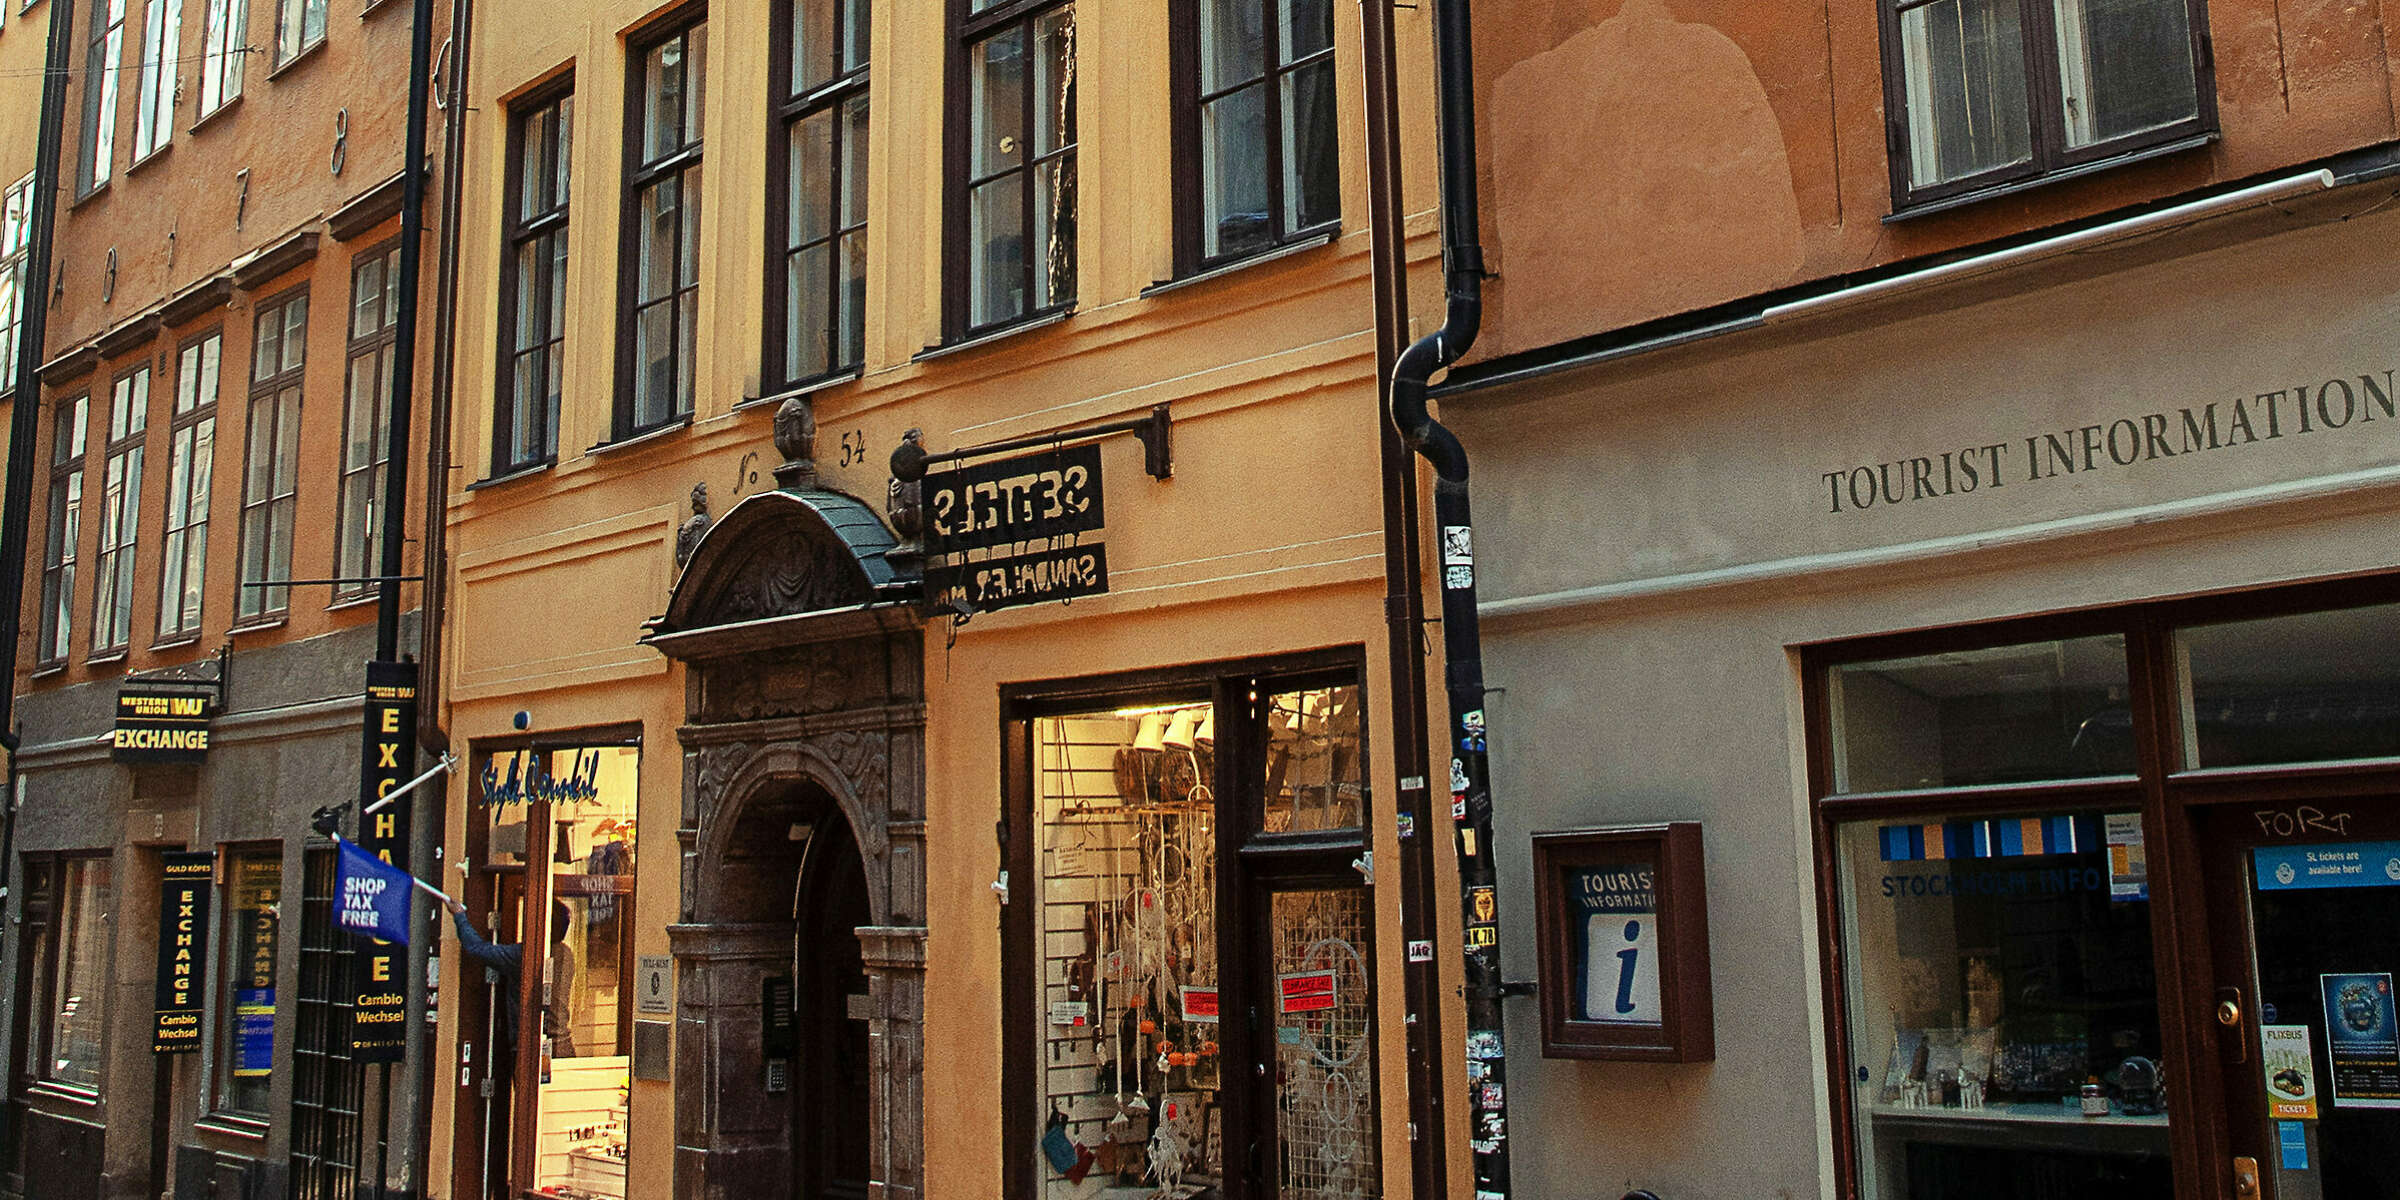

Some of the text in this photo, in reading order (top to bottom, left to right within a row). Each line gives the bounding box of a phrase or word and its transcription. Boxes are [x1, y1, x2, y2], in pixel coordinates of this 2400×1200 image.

[1822, 369, 2397, 513] TOURIST INFORMATION
[121, 697, 168, 706] WESTERN
[135, 706, 168, 714] UNION
[114, 729, 208, 749] EXCHANGE
[2319, 852, 2344, 861] tickets
[2346, 852, 2360, 860] are
[345, 877, 386, 895] SHOP
[1582, 871, 1655, 893] TOURIS
[1881, 872, 2028, 897] STOCKHOLM
[2039, 868, 2100, 893] INFO
[344, 894, 373, 910] TAX
[341, 910, 379, 927] FREE
[174, 890, 194, 1005] EXCHANGE
[357, 993, 403, 1006] Cambio
[160, 1014, 197, 1026] Cambio
[356, 1010, 404, 1023] Wechsel
[158, 1028, 197, 1039] Wechsel
[2267, 1031, 2303, 1040] FLIXBUS
[2278, 1105, 2307, 1113] TICKETS
